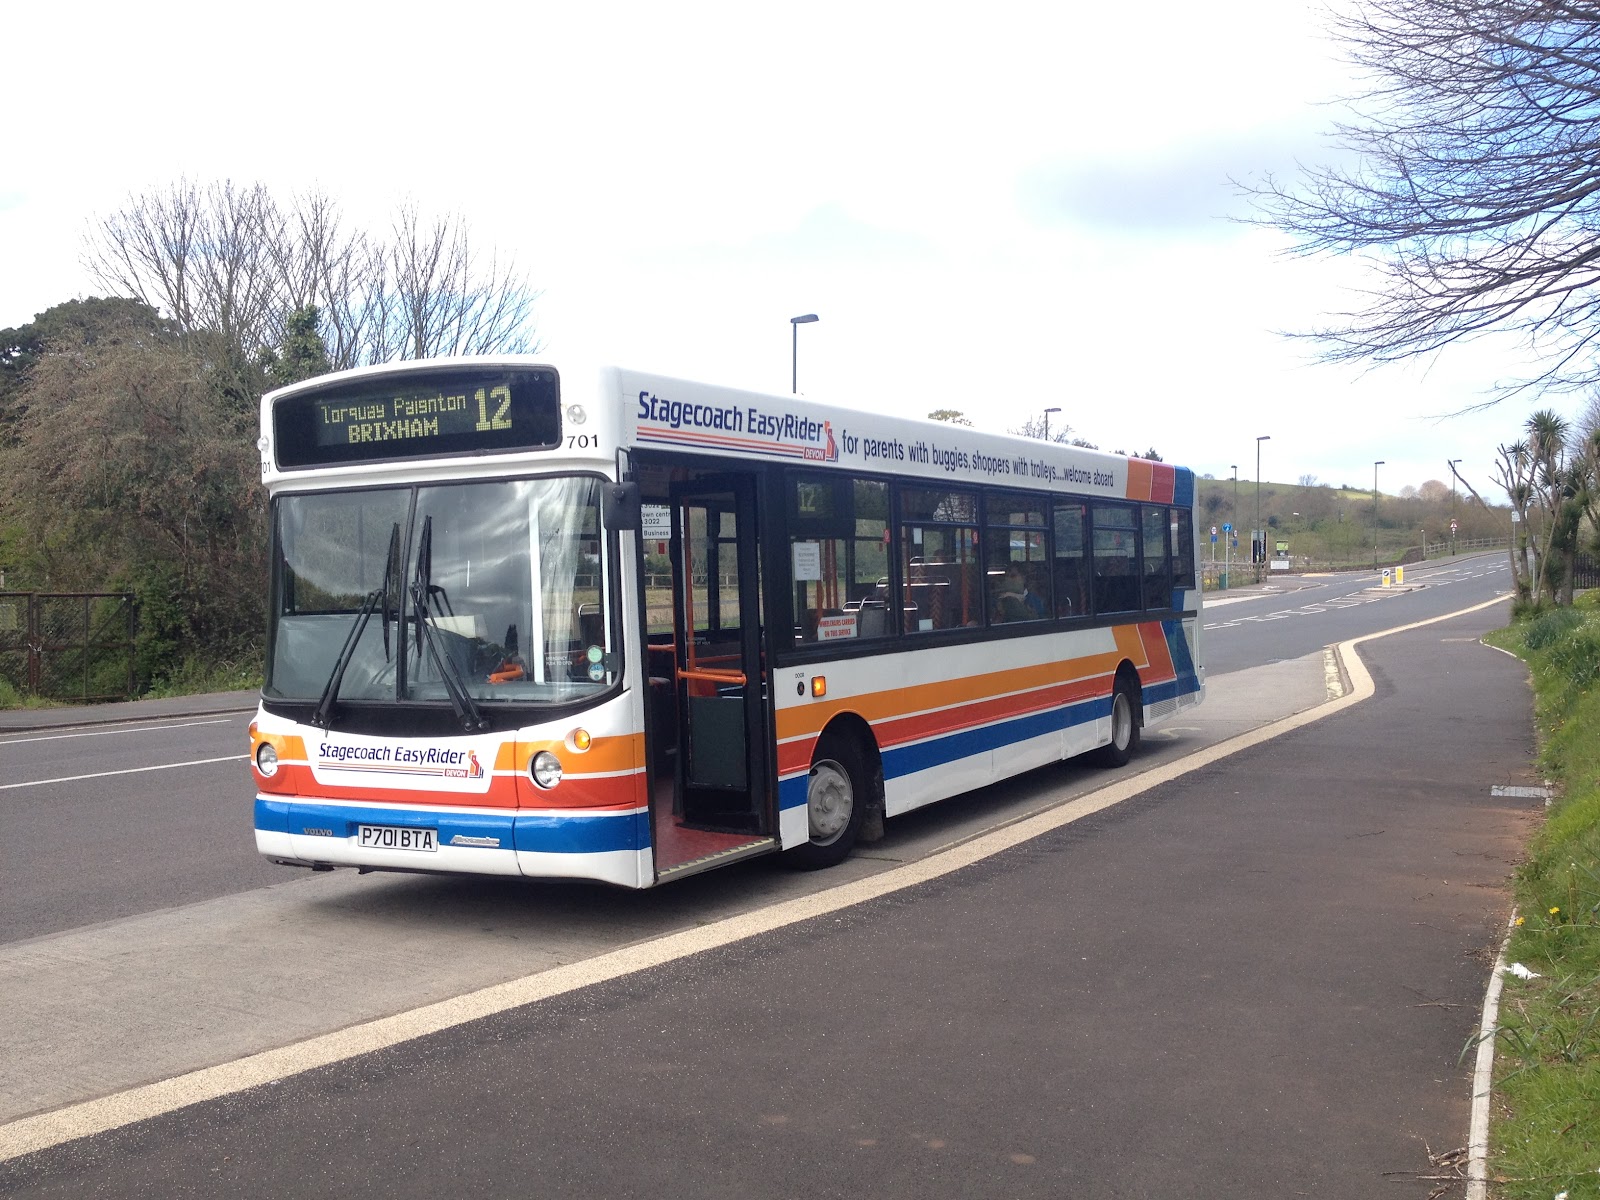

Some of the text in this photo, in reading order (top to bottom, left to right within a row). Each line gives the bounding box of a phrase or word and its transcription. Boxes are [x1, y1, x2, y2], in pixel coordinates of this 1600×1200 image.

[321, 393, 466, 424] Torquay Paignton
[474, 386, 512, 431] 12
[637, 391, 824, 442] Stagecoach EasyRider
[348, 416, 439, 444] BRIXHAM
[566, 435, 599, 449] 701
[805, 449, 824, 460] DEVON
[842, 429, 859, 454] for
[864, 437, 904, 461] parents
[908, 441, 929, 465] with
[932, 443, 971, 473] buggies,
[972, 450, 1010, 477] shoppers
[1012, 456, 1029, 477] with
[1093, 468, 1114, 488] aboard
[318, 742, 466, 766] Stagecoach EasyRider
[445, 769, 468, 778] DEVON
[303, 827, 333, 837] VOLVO
[362, 827, 433, 850] P701 BTA
